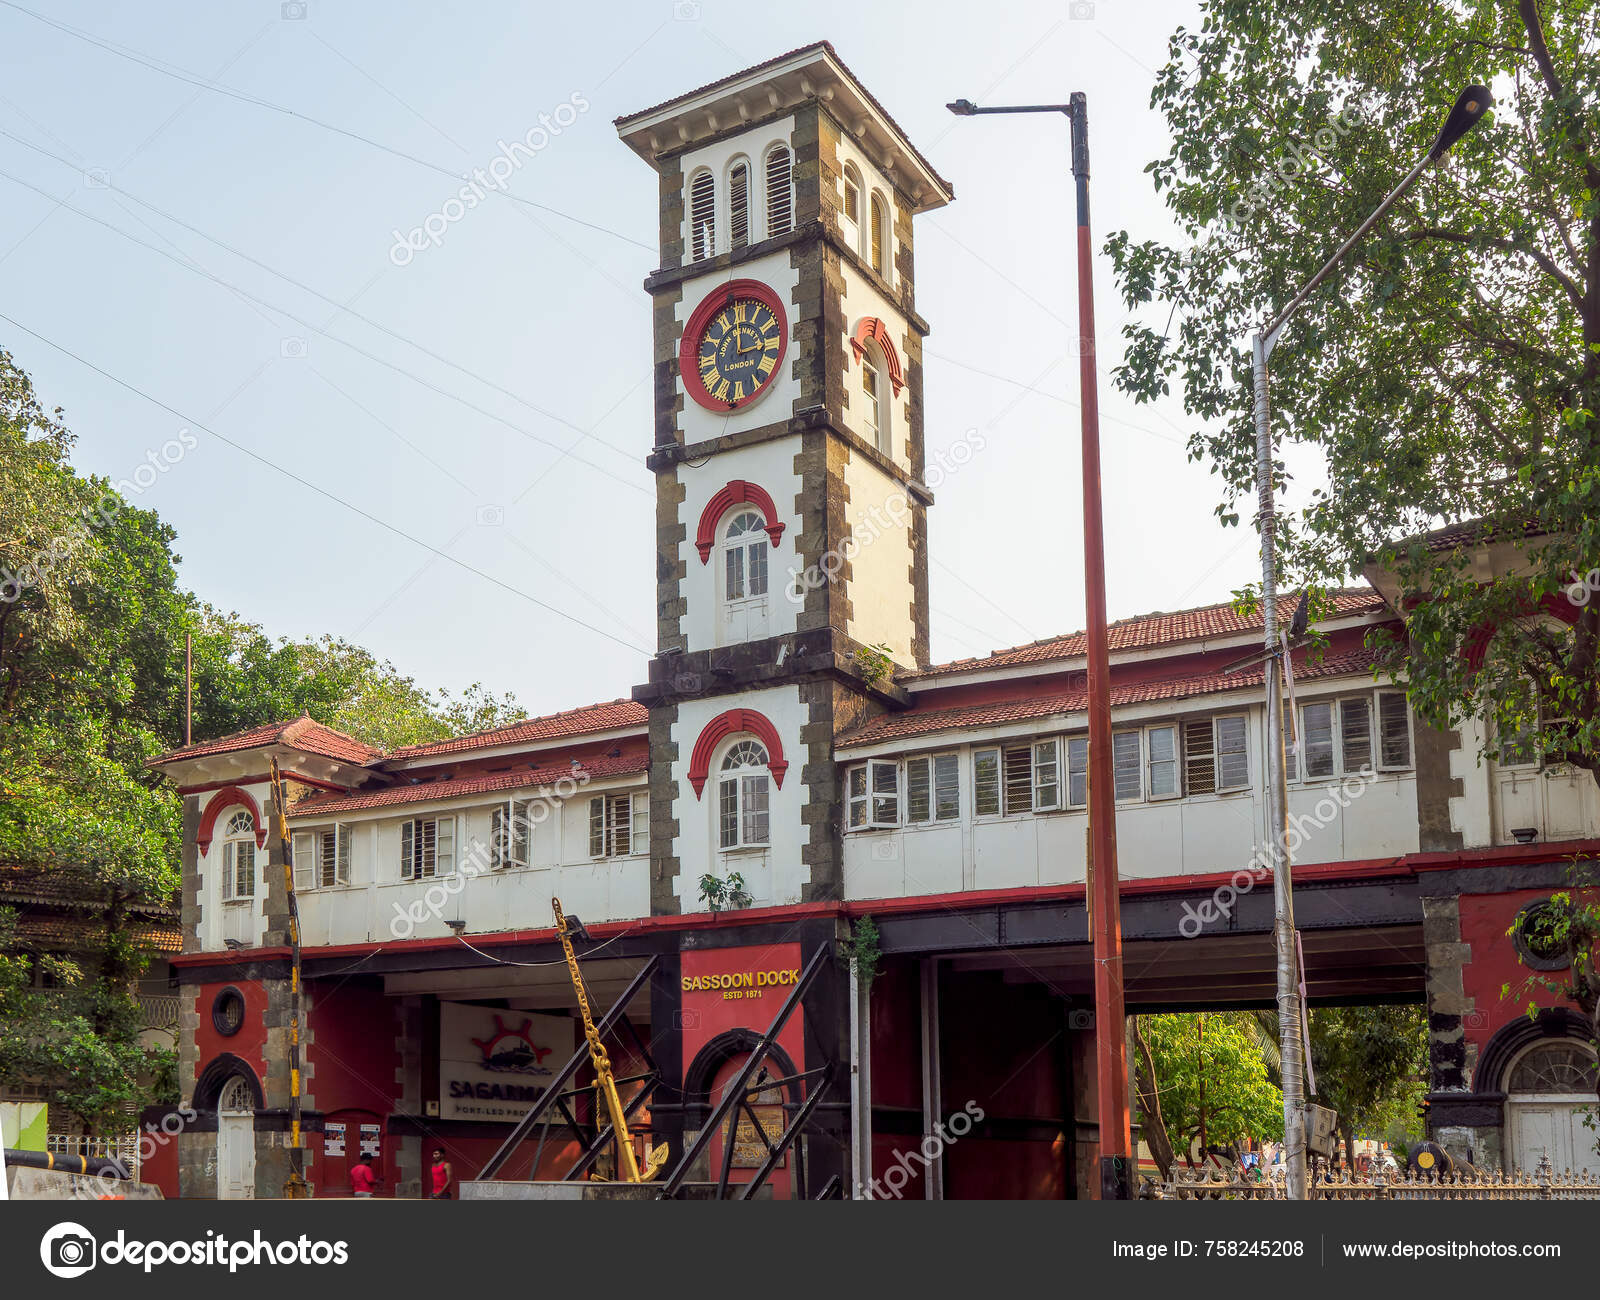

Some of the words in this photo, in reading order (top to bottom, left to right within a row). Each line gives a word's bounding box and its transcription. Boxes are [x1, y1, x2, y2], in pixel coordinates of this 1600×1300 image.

[719, 338, 732, 358] JOHN
[724, 359, 755, 371] LONDON
[681, 972, 753, 991] SASSOON
[757, 969, 800, 986] DOCK
[723, 991, 743, 1001] ESTD
[745, 990, 762, 999] 1871
[449, 1080, 572, 1104] SAGARMA
